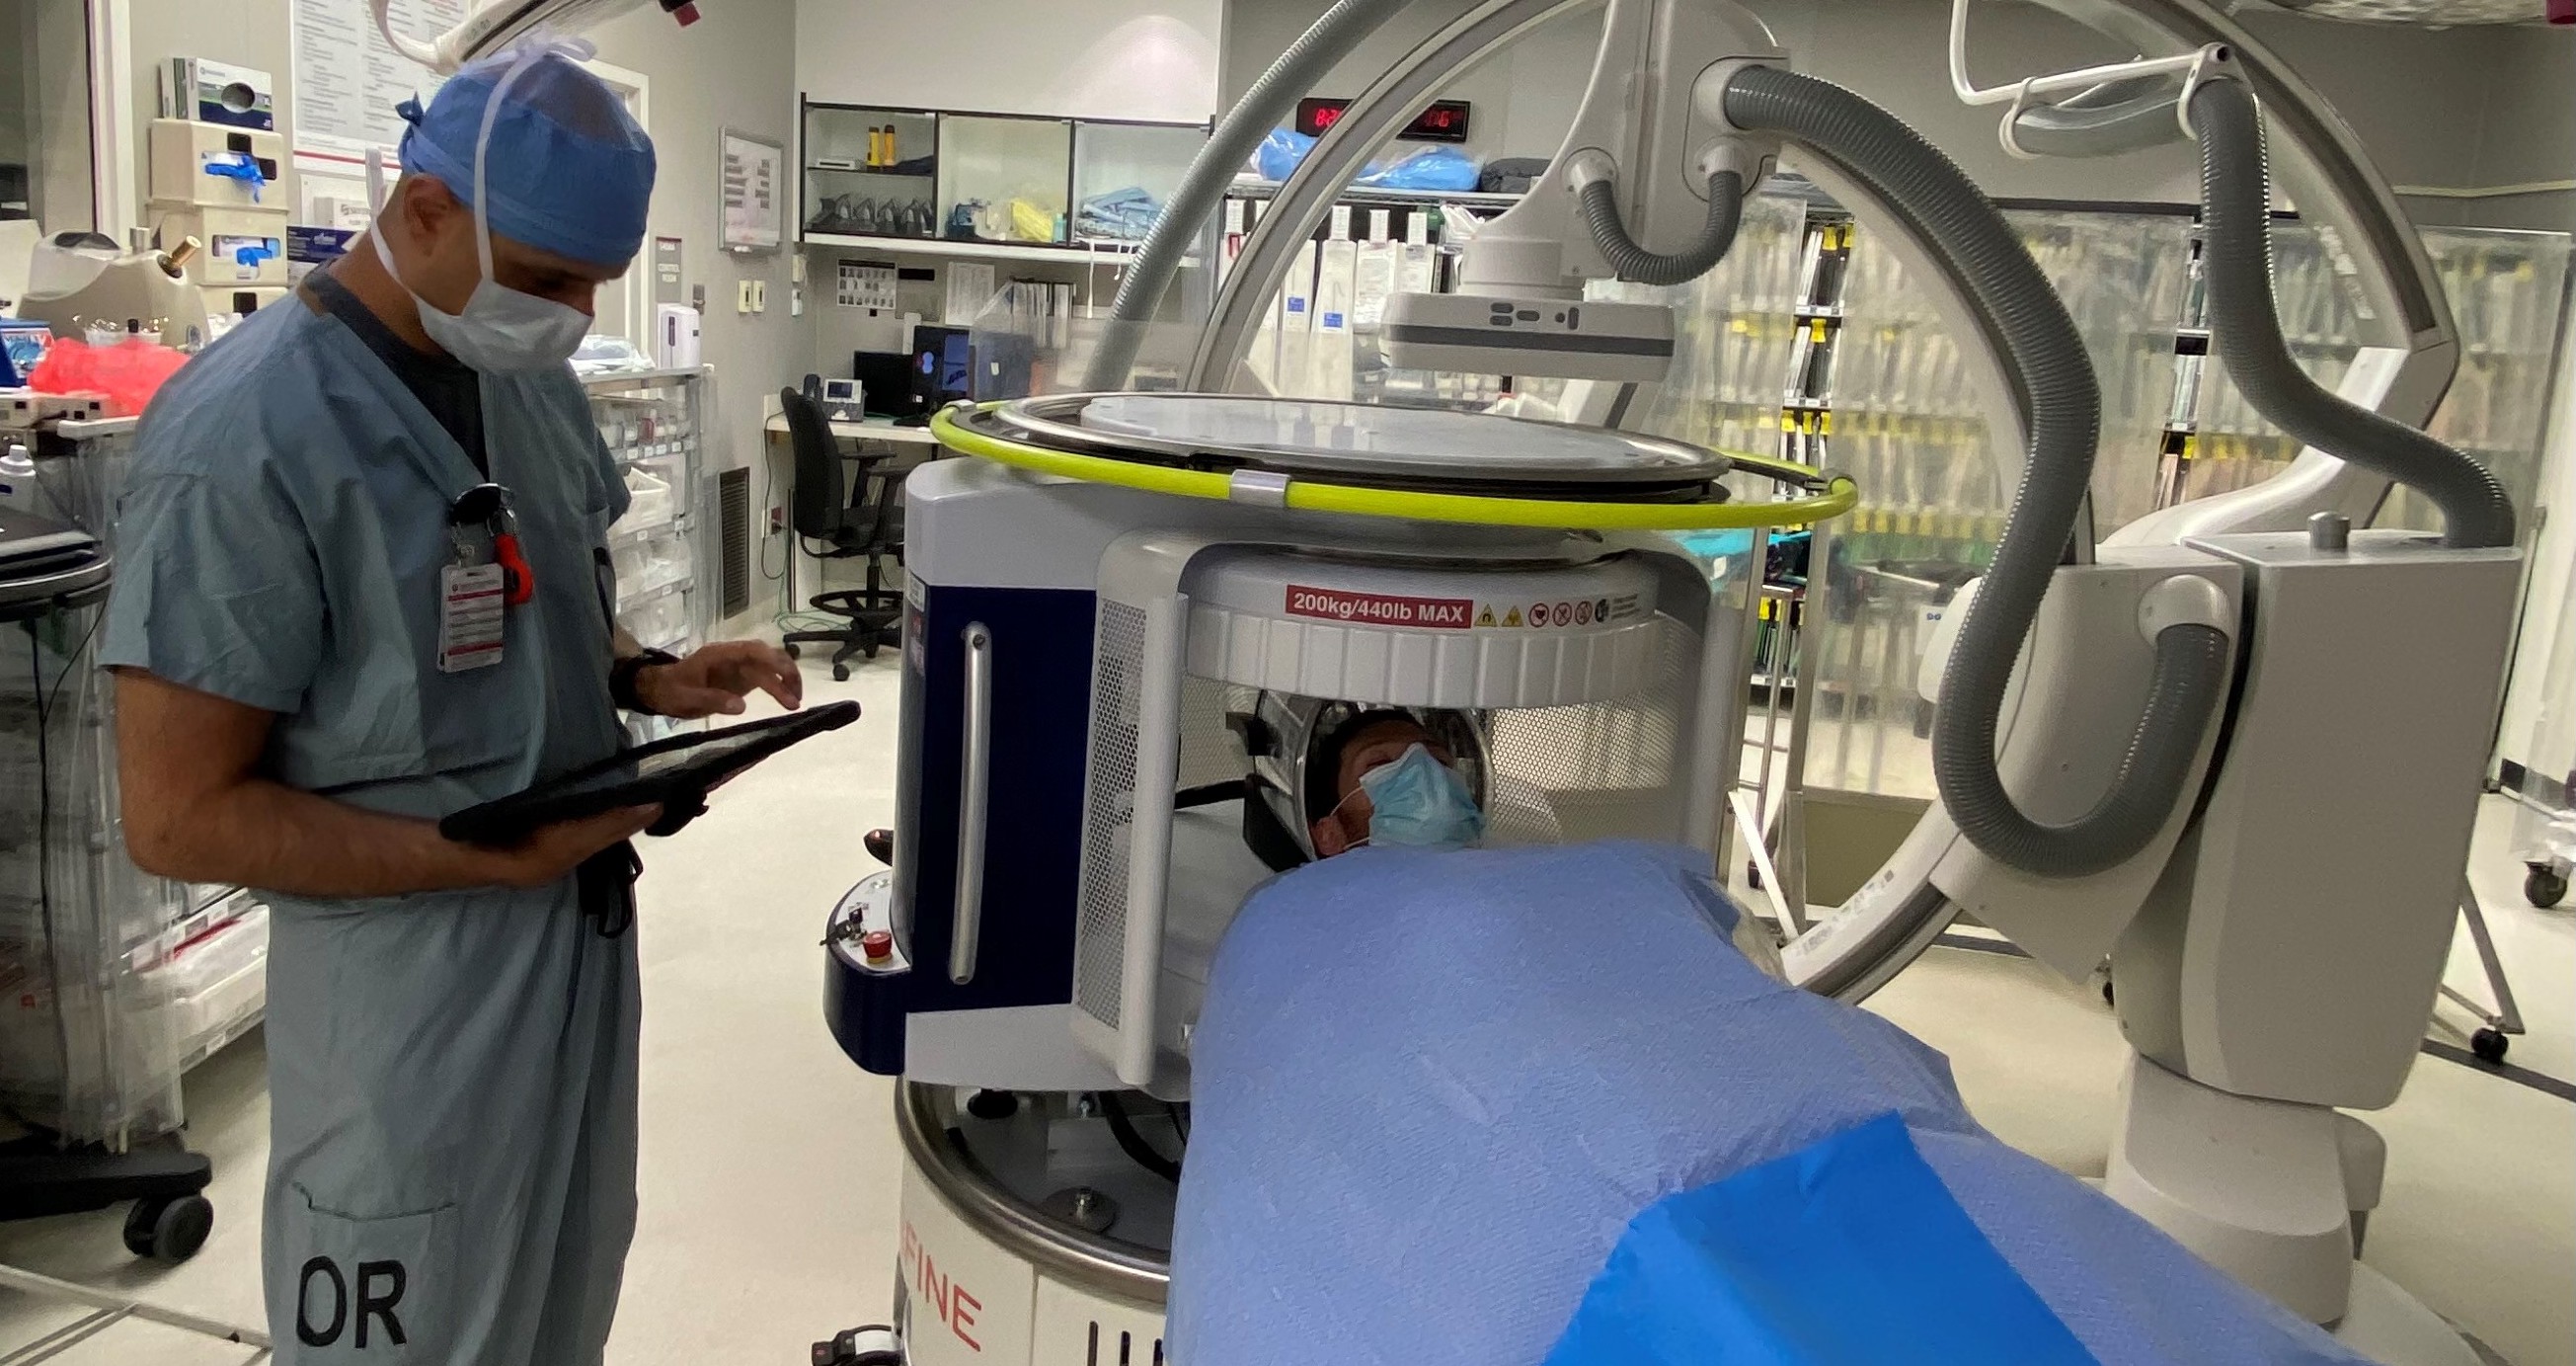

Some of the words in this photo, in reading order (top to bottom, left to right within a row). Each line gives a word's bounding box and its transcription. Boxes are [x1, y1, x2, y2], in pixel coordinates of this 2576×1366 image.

[1293, 592, 1412, 619] 200kg/440lb
[1418, 603, 1463, 623] MAX
[297, 1255, 407, 1349] OR
